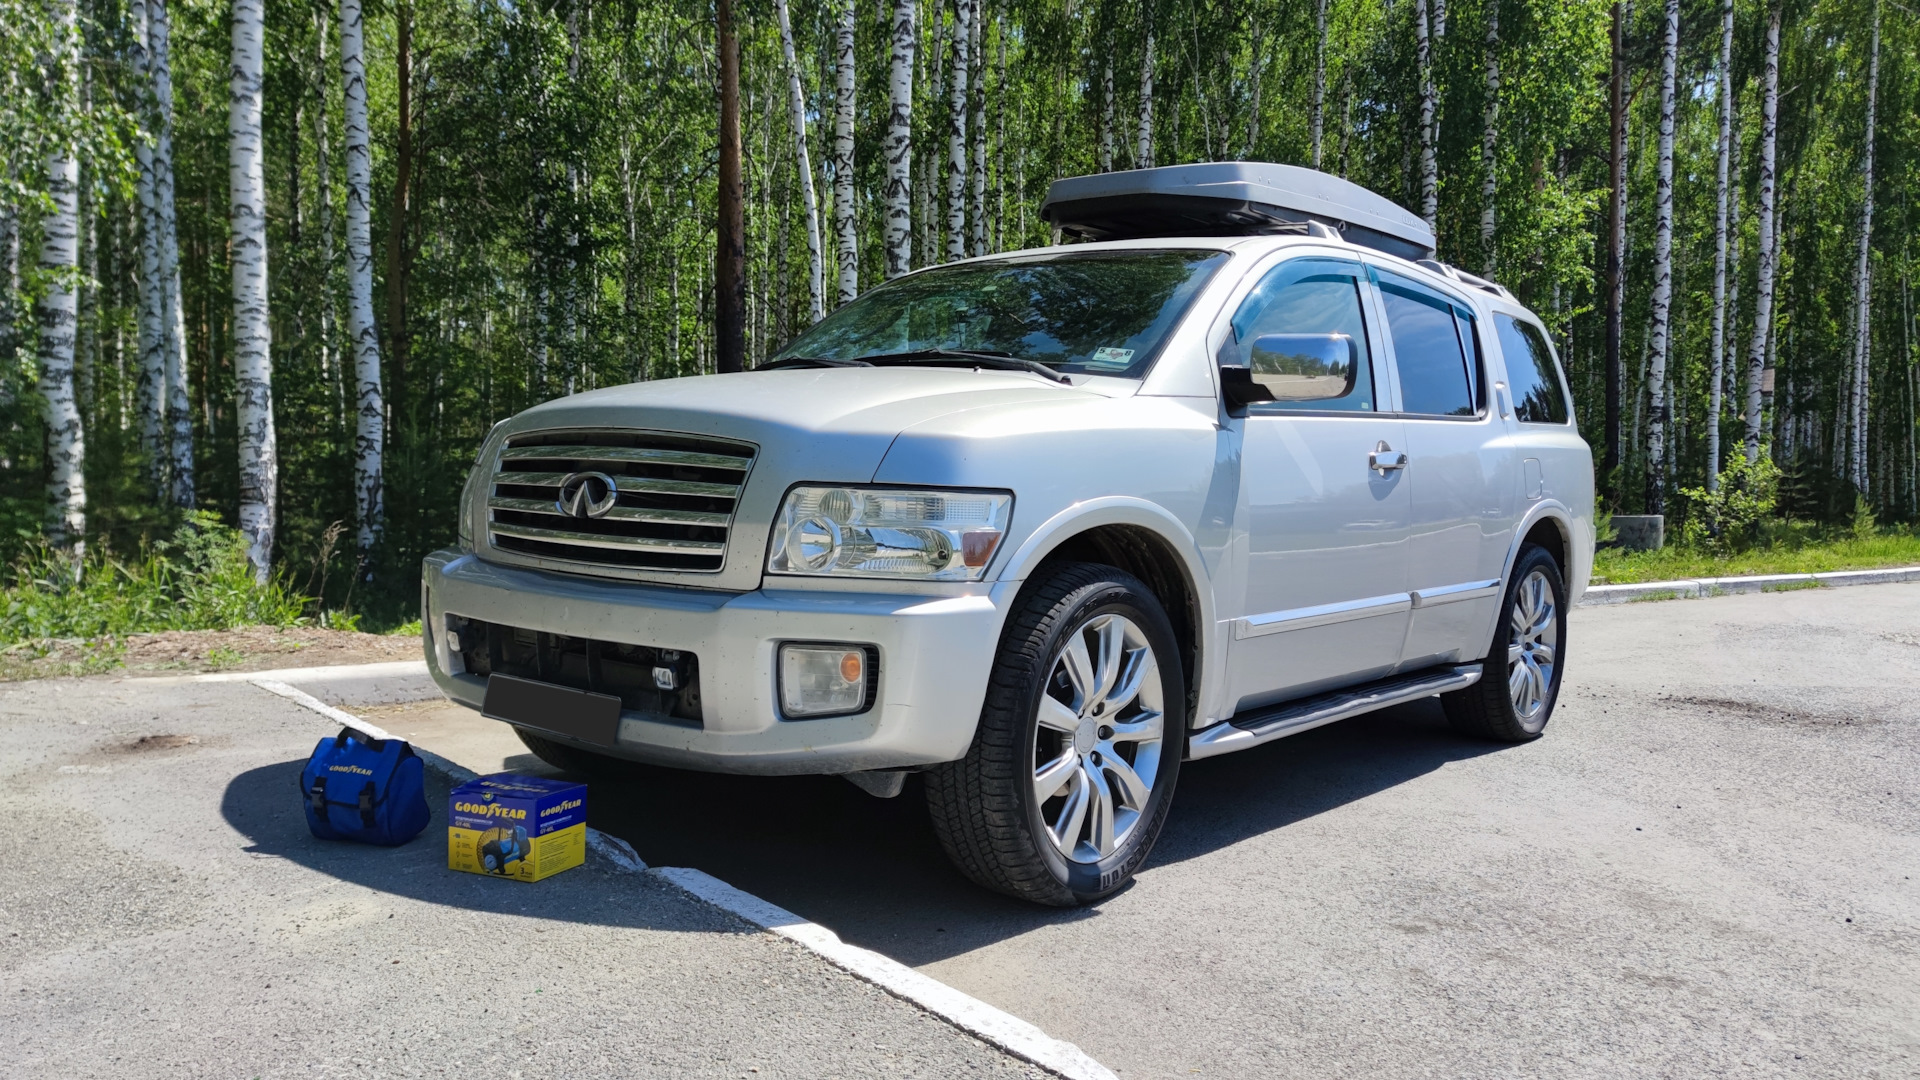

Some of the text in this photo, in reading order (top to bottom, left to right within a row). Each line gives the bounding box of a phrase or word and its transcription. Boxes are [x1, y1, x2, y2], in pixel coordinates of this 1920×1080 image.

[329, 765, 373, 776] GOODYEAR
[455, 802, 527, 820] GOODYEAR
[540, 799, 582, 818] GOODYEAR
